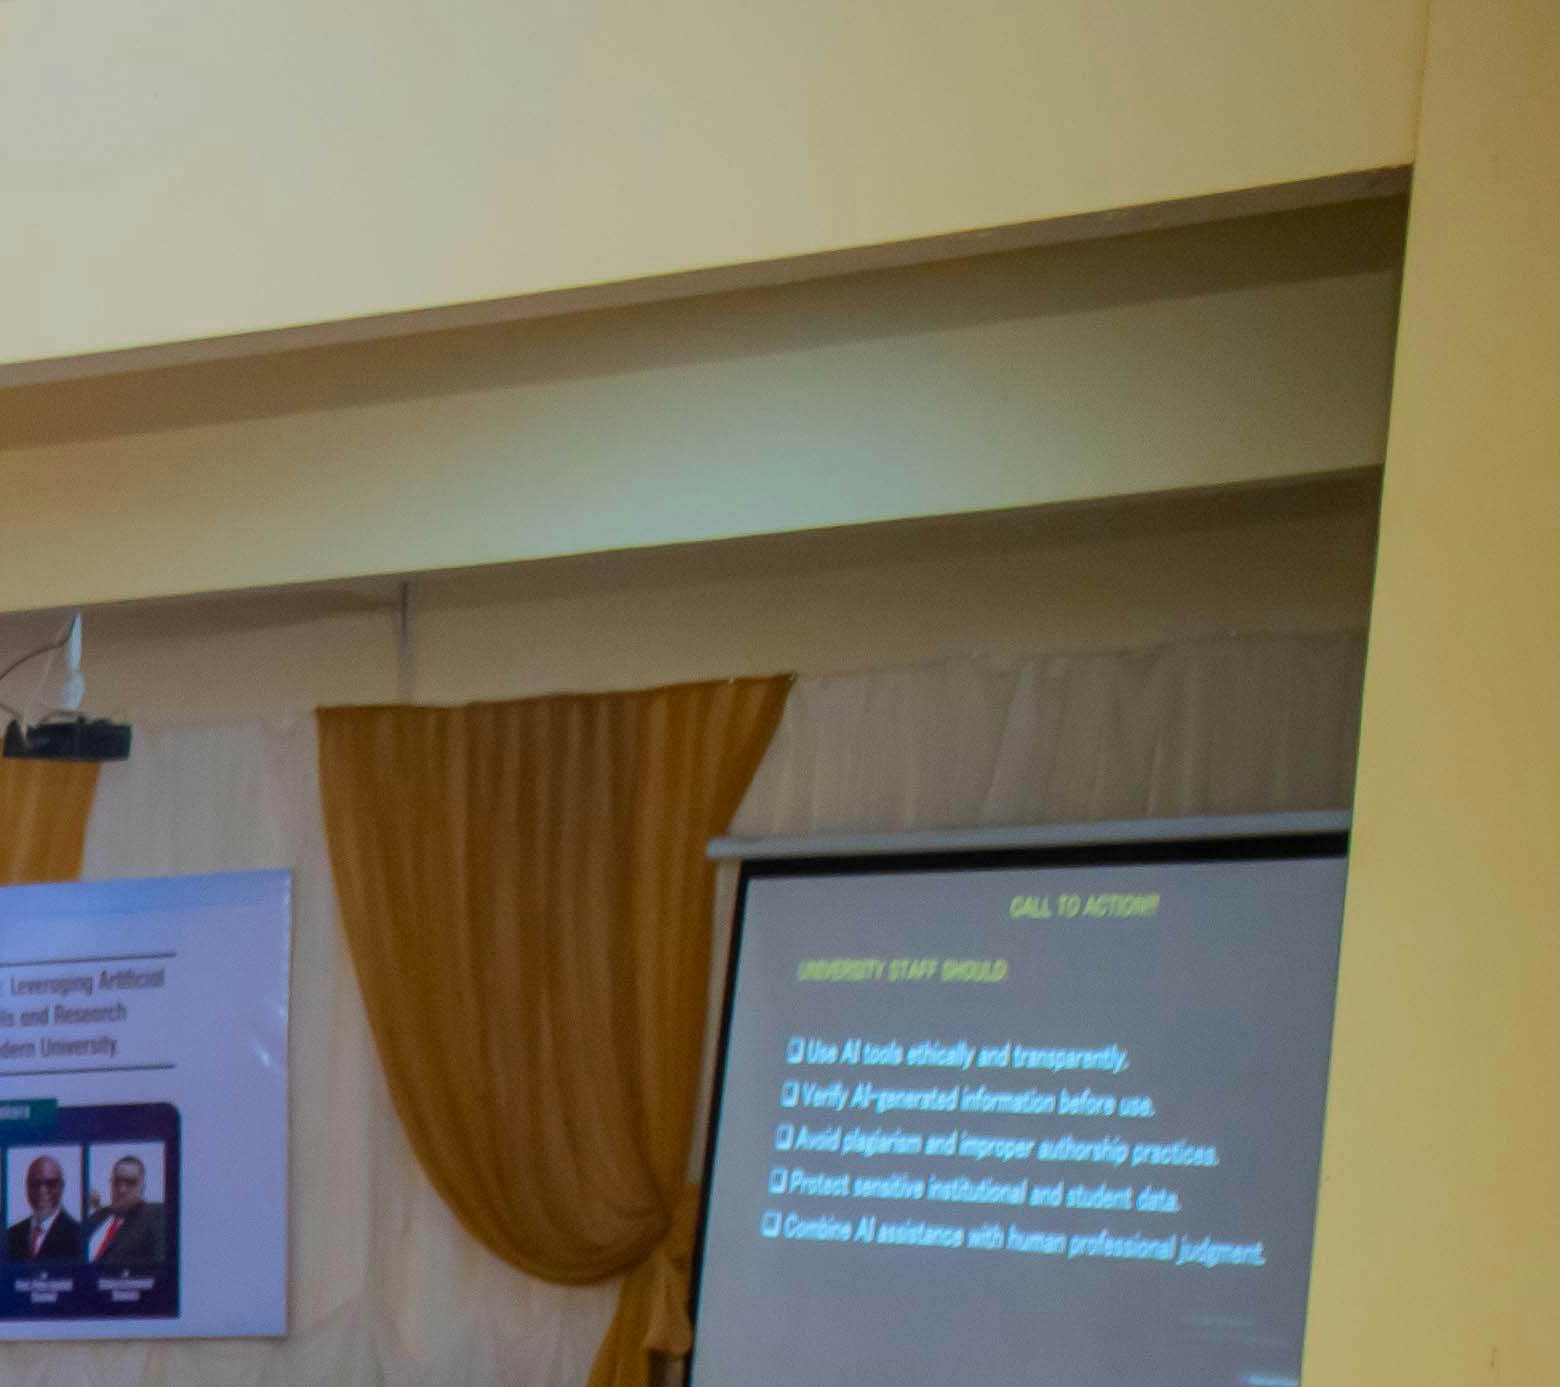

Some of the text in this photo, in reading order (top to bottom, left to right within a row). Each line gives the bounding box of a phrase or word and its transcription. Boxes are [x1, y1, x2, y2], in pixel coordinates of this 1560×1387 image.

[1009, 895, 1052, 919] CALL
[1056, 895, 1082, 918] TO
[11, 976, 93, 997] Leveraging
[98, 968, 165, 989] Artificial
[887, 958, 939, 982] STAFF
[21, 1006, 49, 1026] and
[54, 1002, 127, 1024] Research
[806, 1039, 1128, 1074] Use AI tools ethically and transparently.
[801, 1080, 1156, 1117] Verify AI-generated information before use.
[794, 1125, 1220, 1167] Avoid plagiarism and improper authorship practices.
[788, 1167, 1182, 1213] Protect sensitive institutional and student data.
[782, 1211, 1266, 1268] Combine AI assistance with human professional judgment.
